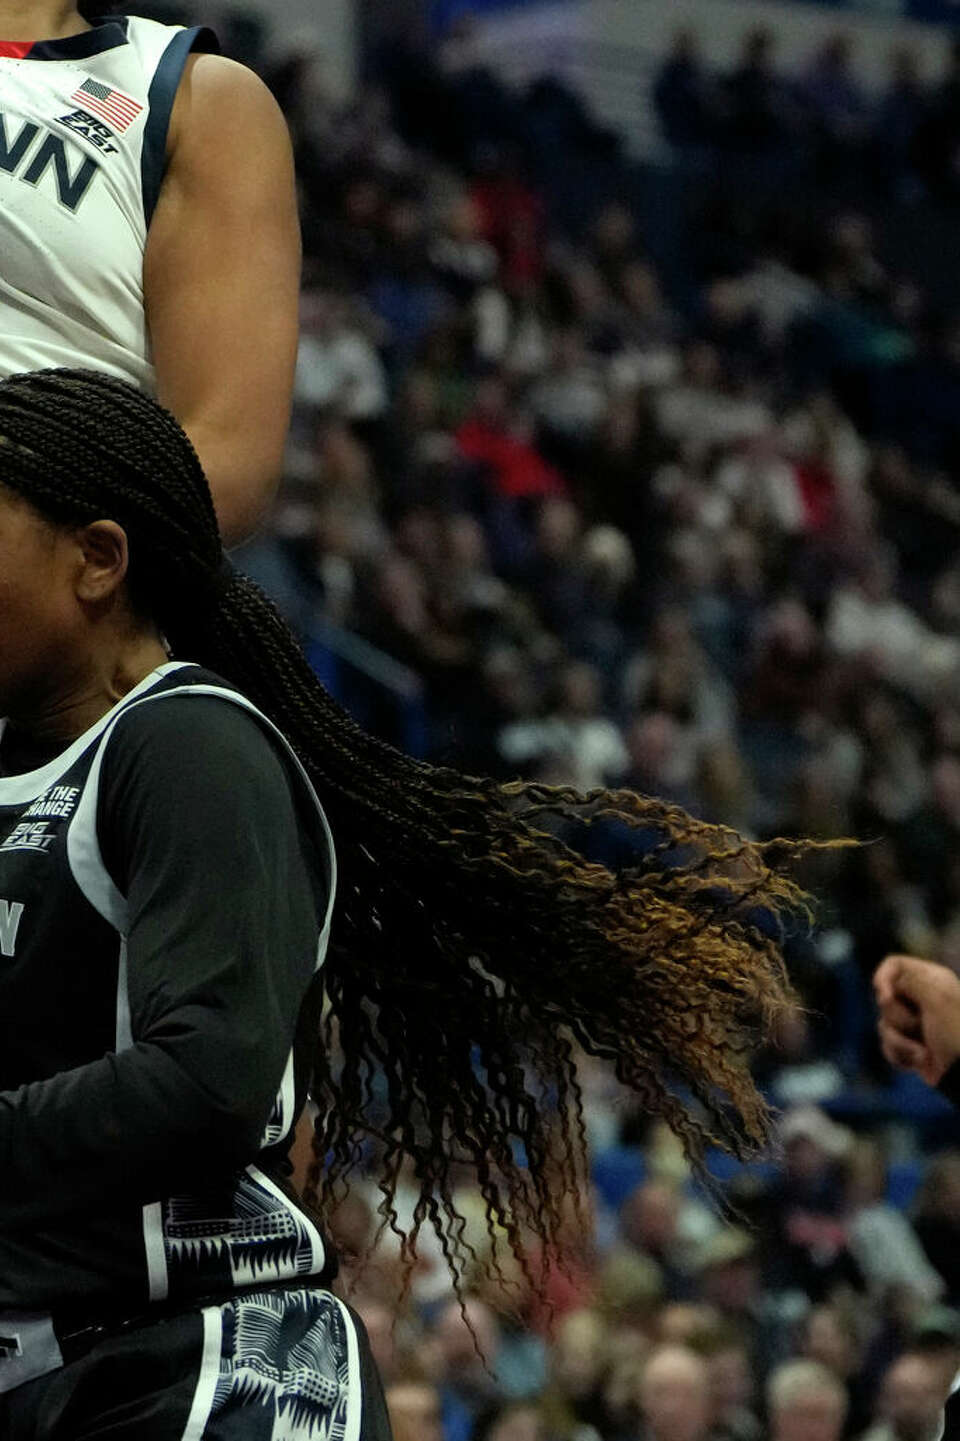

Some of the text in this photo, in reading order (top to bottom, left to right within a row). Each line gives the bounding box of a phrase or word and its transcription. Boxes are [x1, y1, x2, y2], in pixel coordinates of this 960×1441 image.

[71, 109, 115, 138] BIG
[59, 115, 119, 154] EAST
[49, 786, 80, 802] THE
[22, 800, 74, 817] HANGE
[11, 822, 50, 835] BIG
[0, 834, 57, 848] EAST
